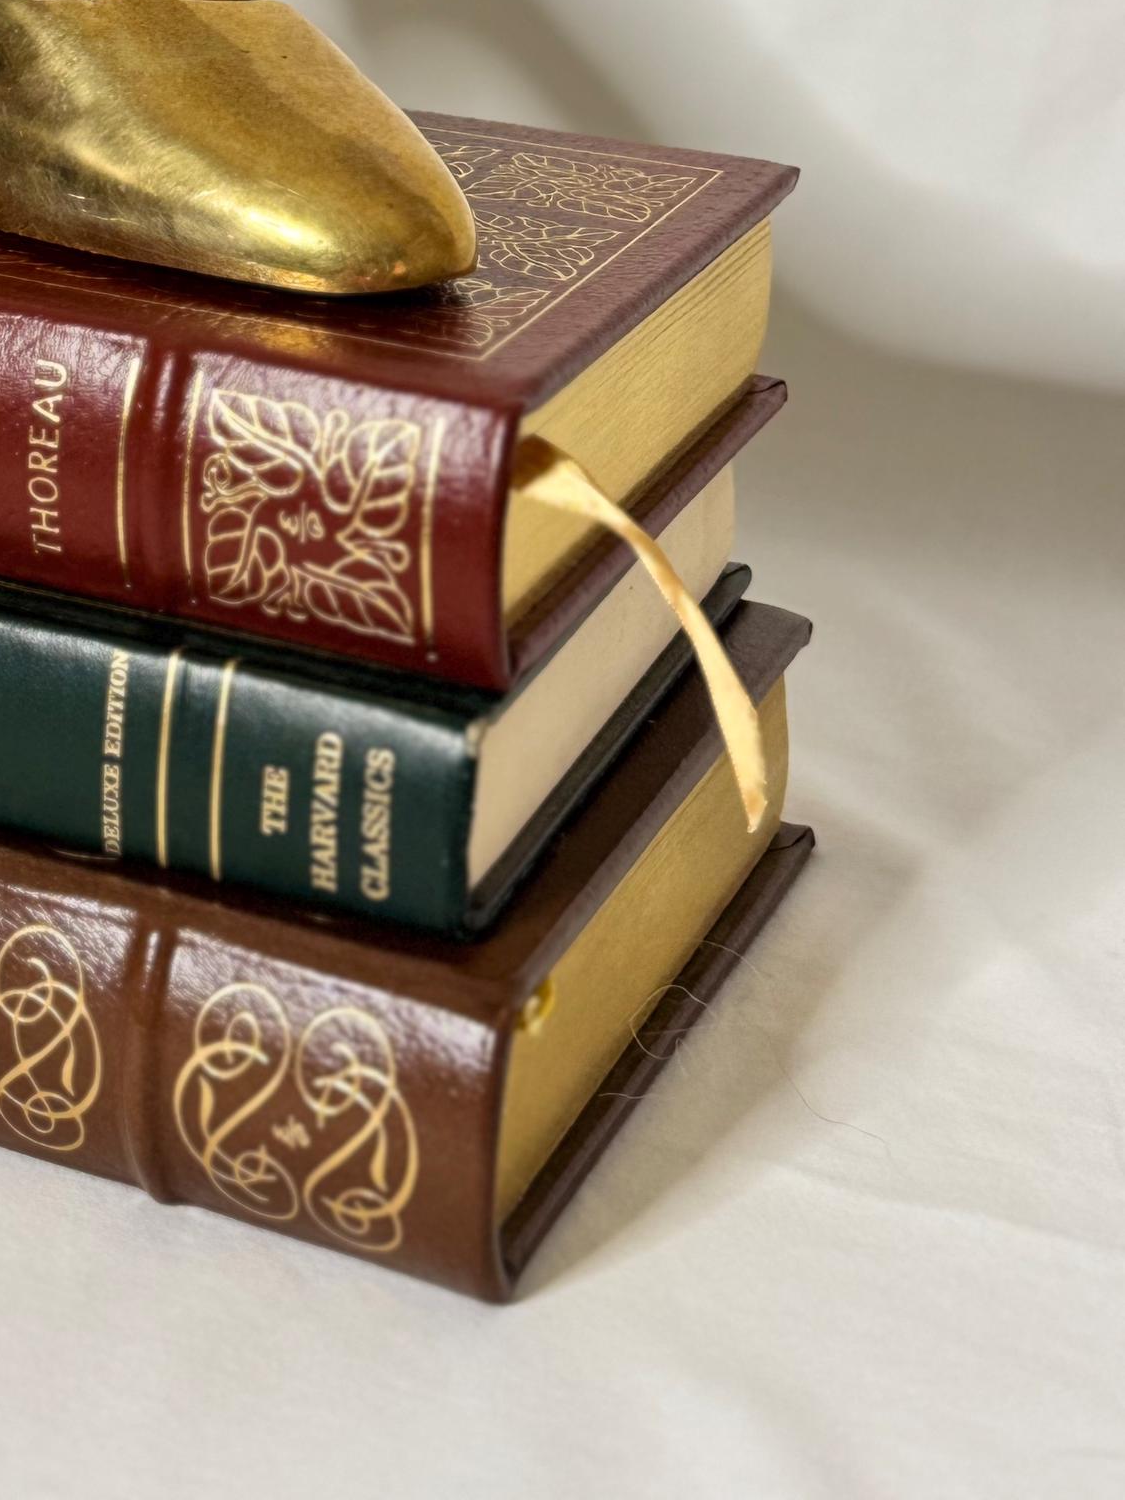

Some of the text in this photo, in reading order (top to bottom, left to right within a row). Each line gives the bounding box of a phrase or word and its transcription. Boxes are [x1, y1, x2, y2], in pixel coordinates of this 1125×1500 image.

[28, 359, 68, 555] THOREAU
[103, 649, 130, 856] DELUXE EDITION
[260, 763, 291, 837] THE
[309, 730, 344, 894] HARVARD
[360, 747, 396, 901] CLASSICS
